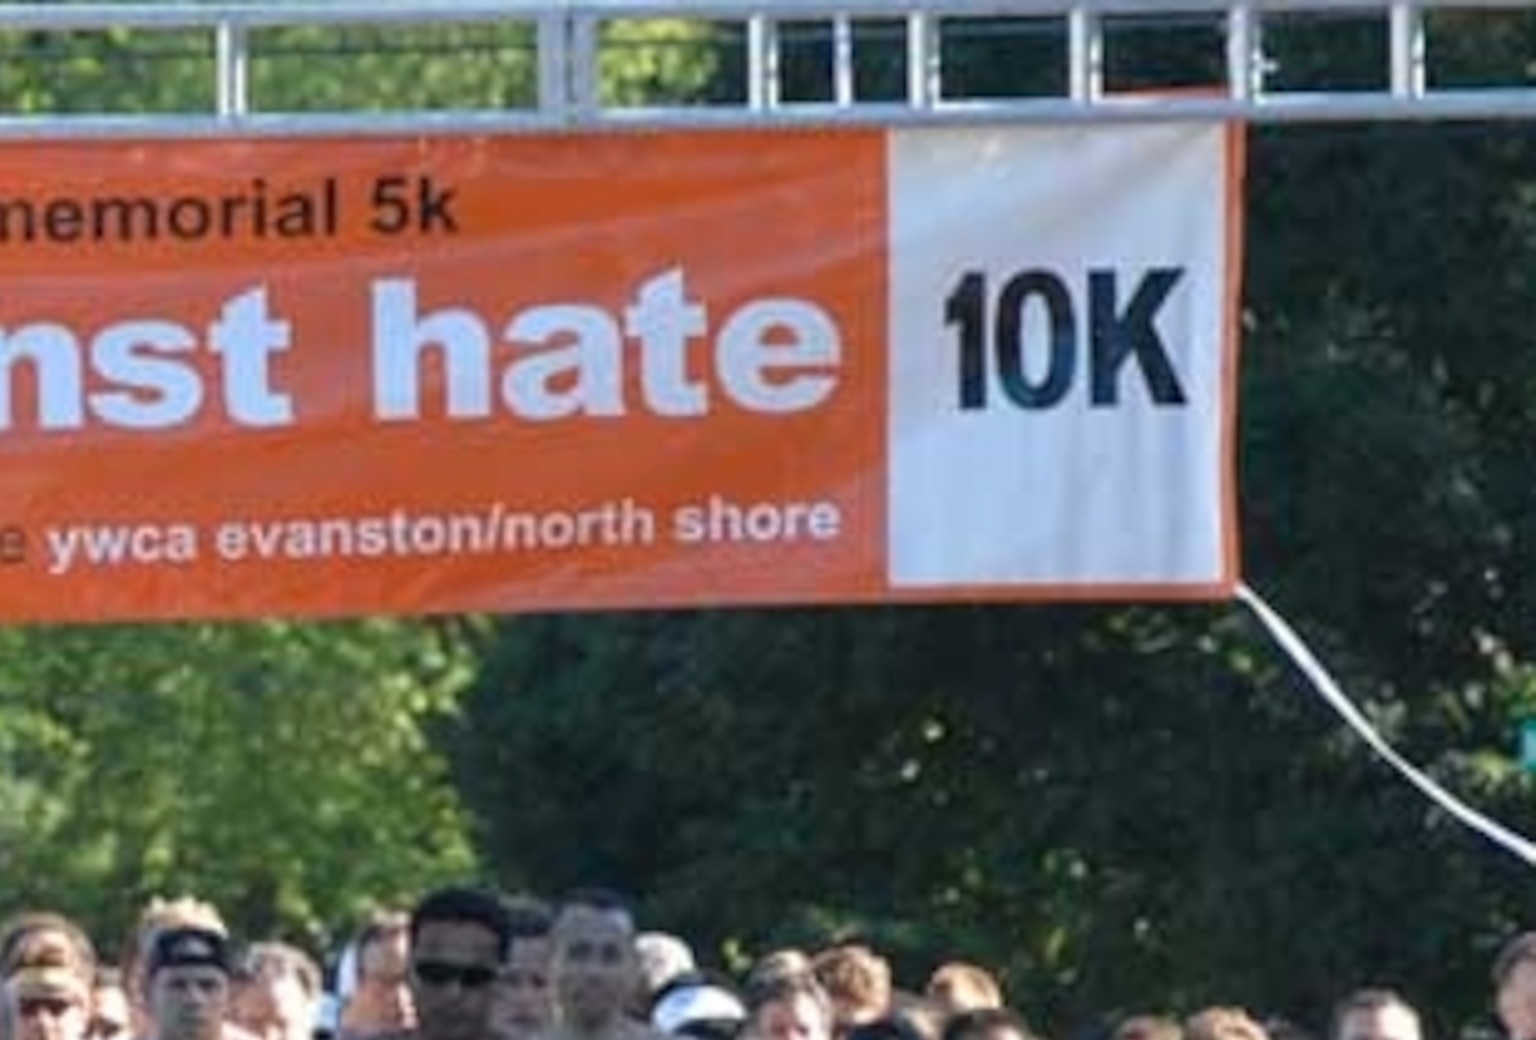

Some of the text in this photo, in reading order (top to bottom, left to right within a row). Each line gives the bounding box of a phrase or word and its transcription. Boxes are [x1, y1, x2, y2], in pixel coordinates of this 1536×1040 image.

[371, 175, 459, 236] 5k
[369, 265, 842, 421] hate
[944, 265, 1189, 410] 10K
[46, 523, 198, 575] ywca
[216, 497, 655, 560] evanston/north
[673, 494, 841, 543] shore
